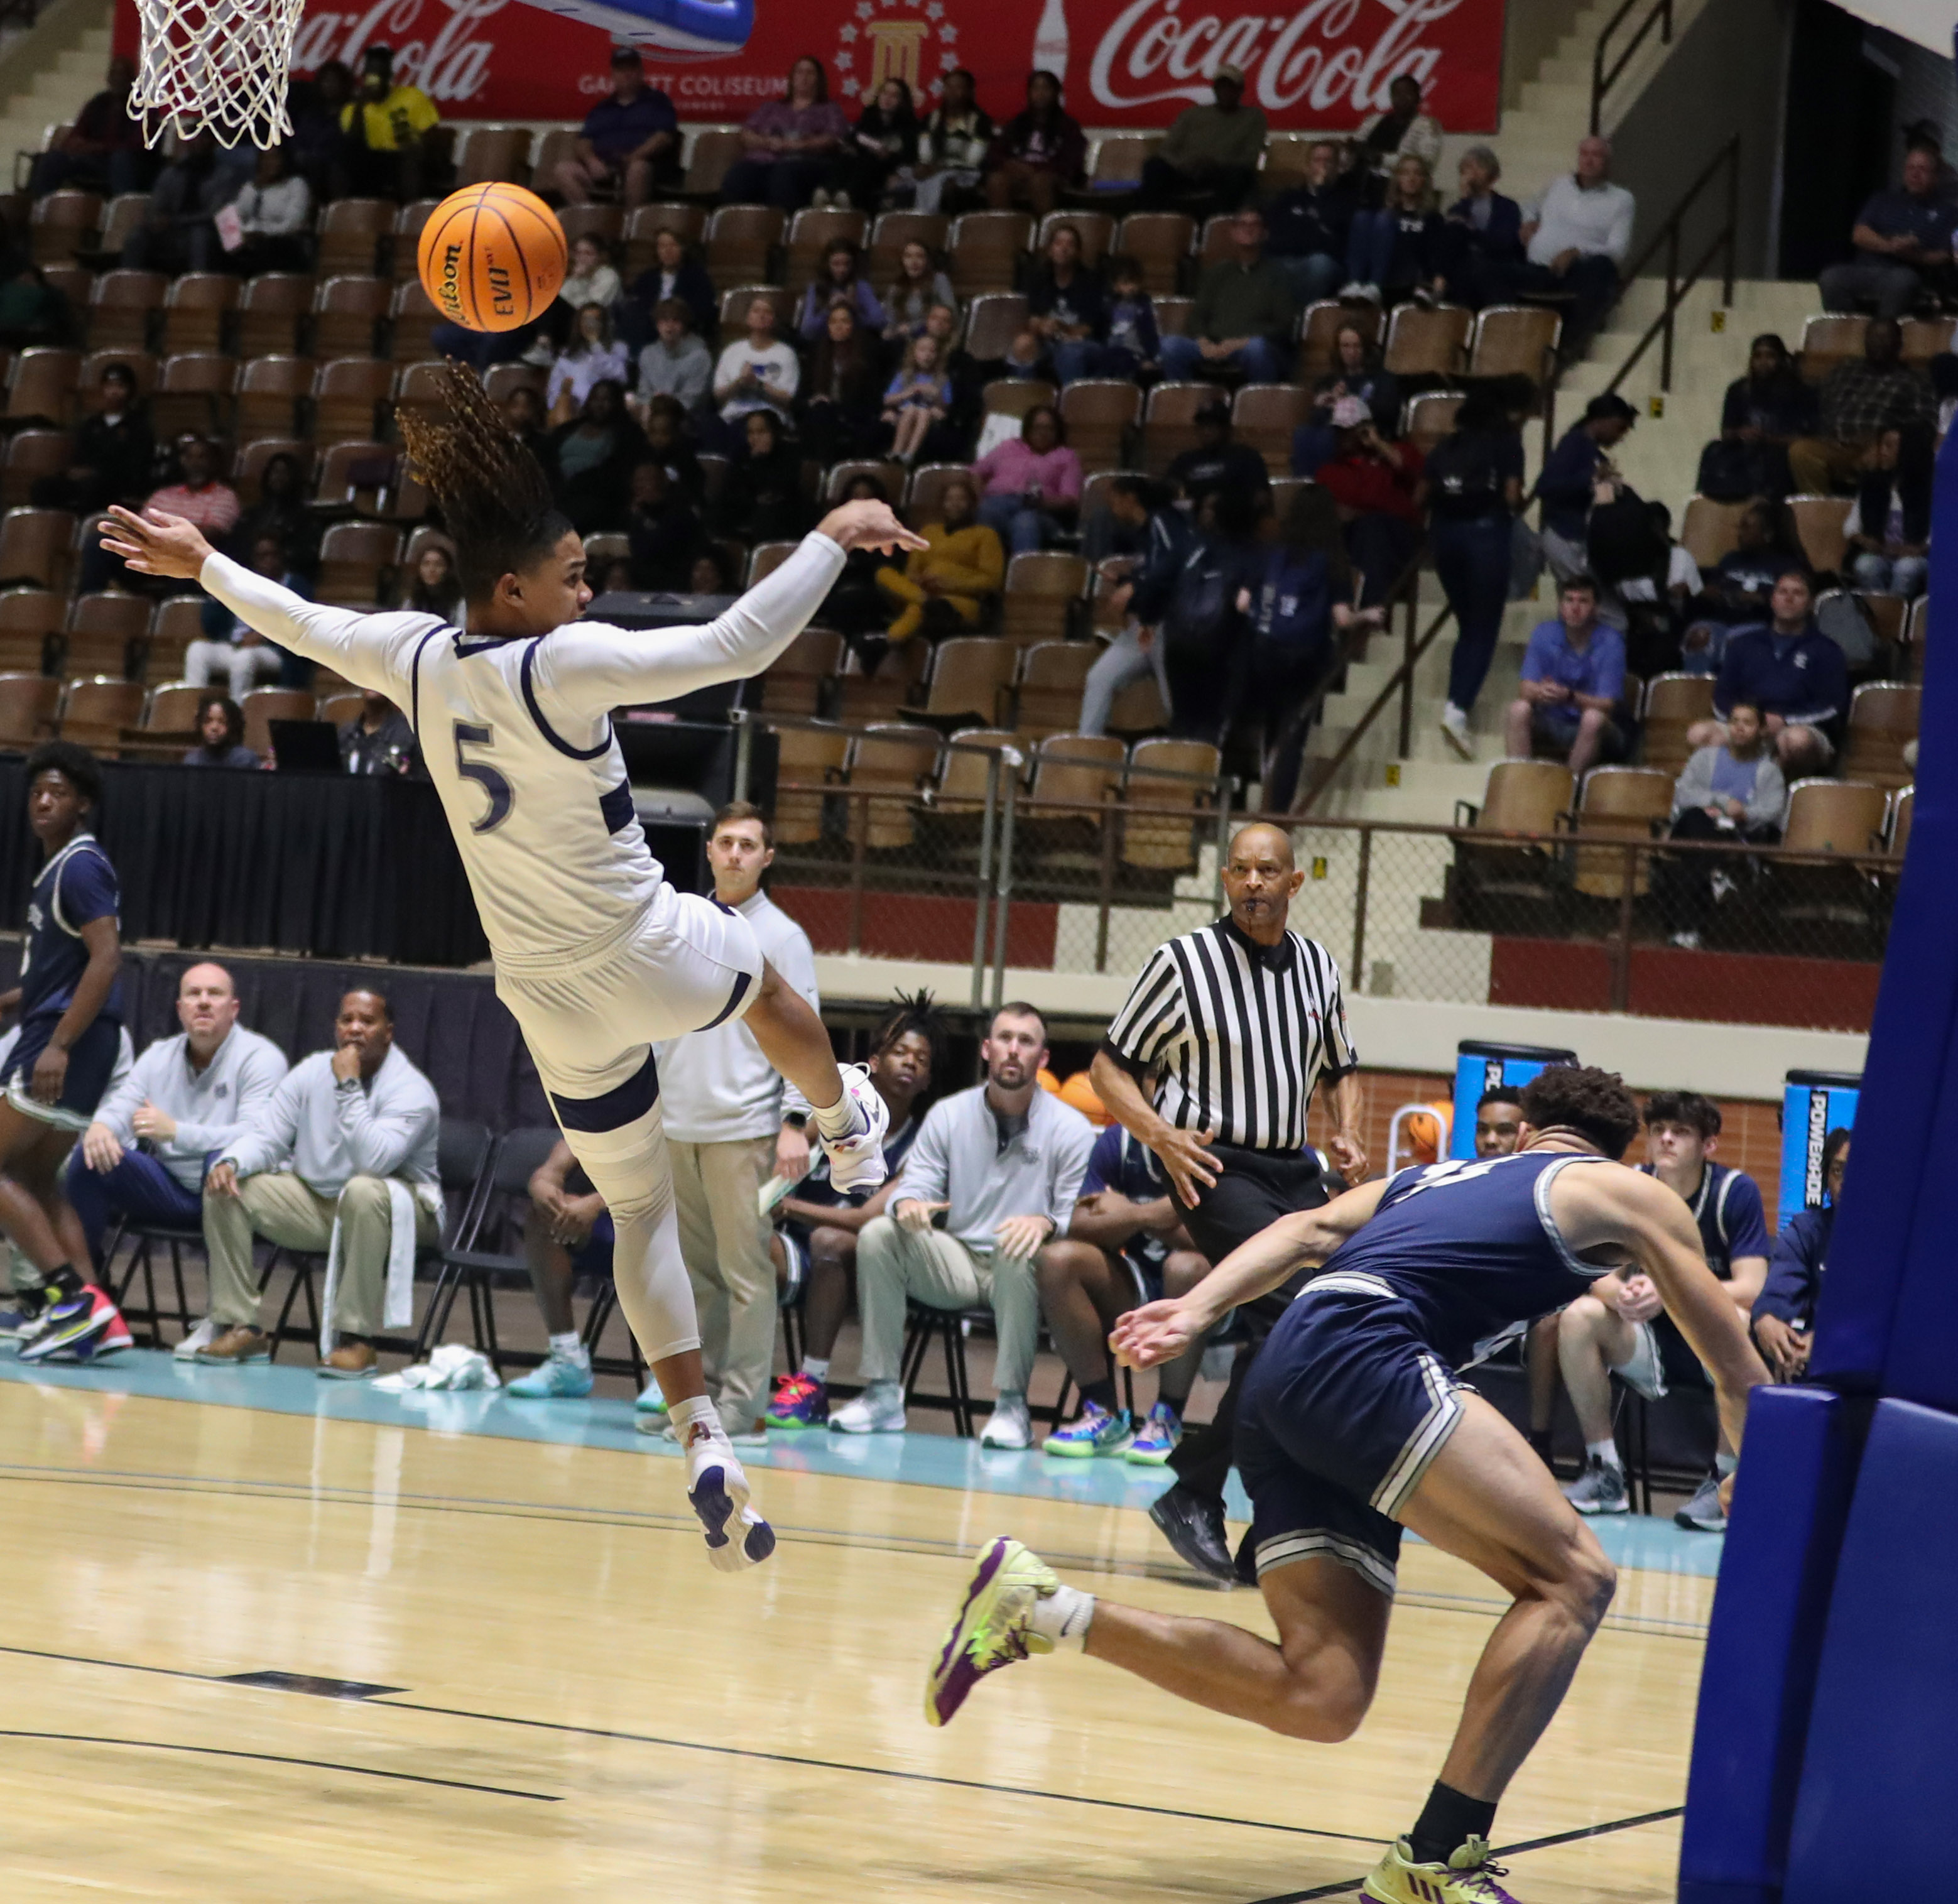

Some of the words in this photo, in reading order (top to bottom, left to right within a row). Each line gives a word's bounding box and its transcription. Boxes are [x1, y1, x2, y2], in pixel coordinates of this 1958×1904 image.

[579, 70, 673, 95] GATT
[679, 70, 788, 95] COLISEUM
[1090, 0, 1462, 111] Coca-Cola
[452, 717, 516, 836] 5
[1806, 1093, 1827, 1205] POWERADE
